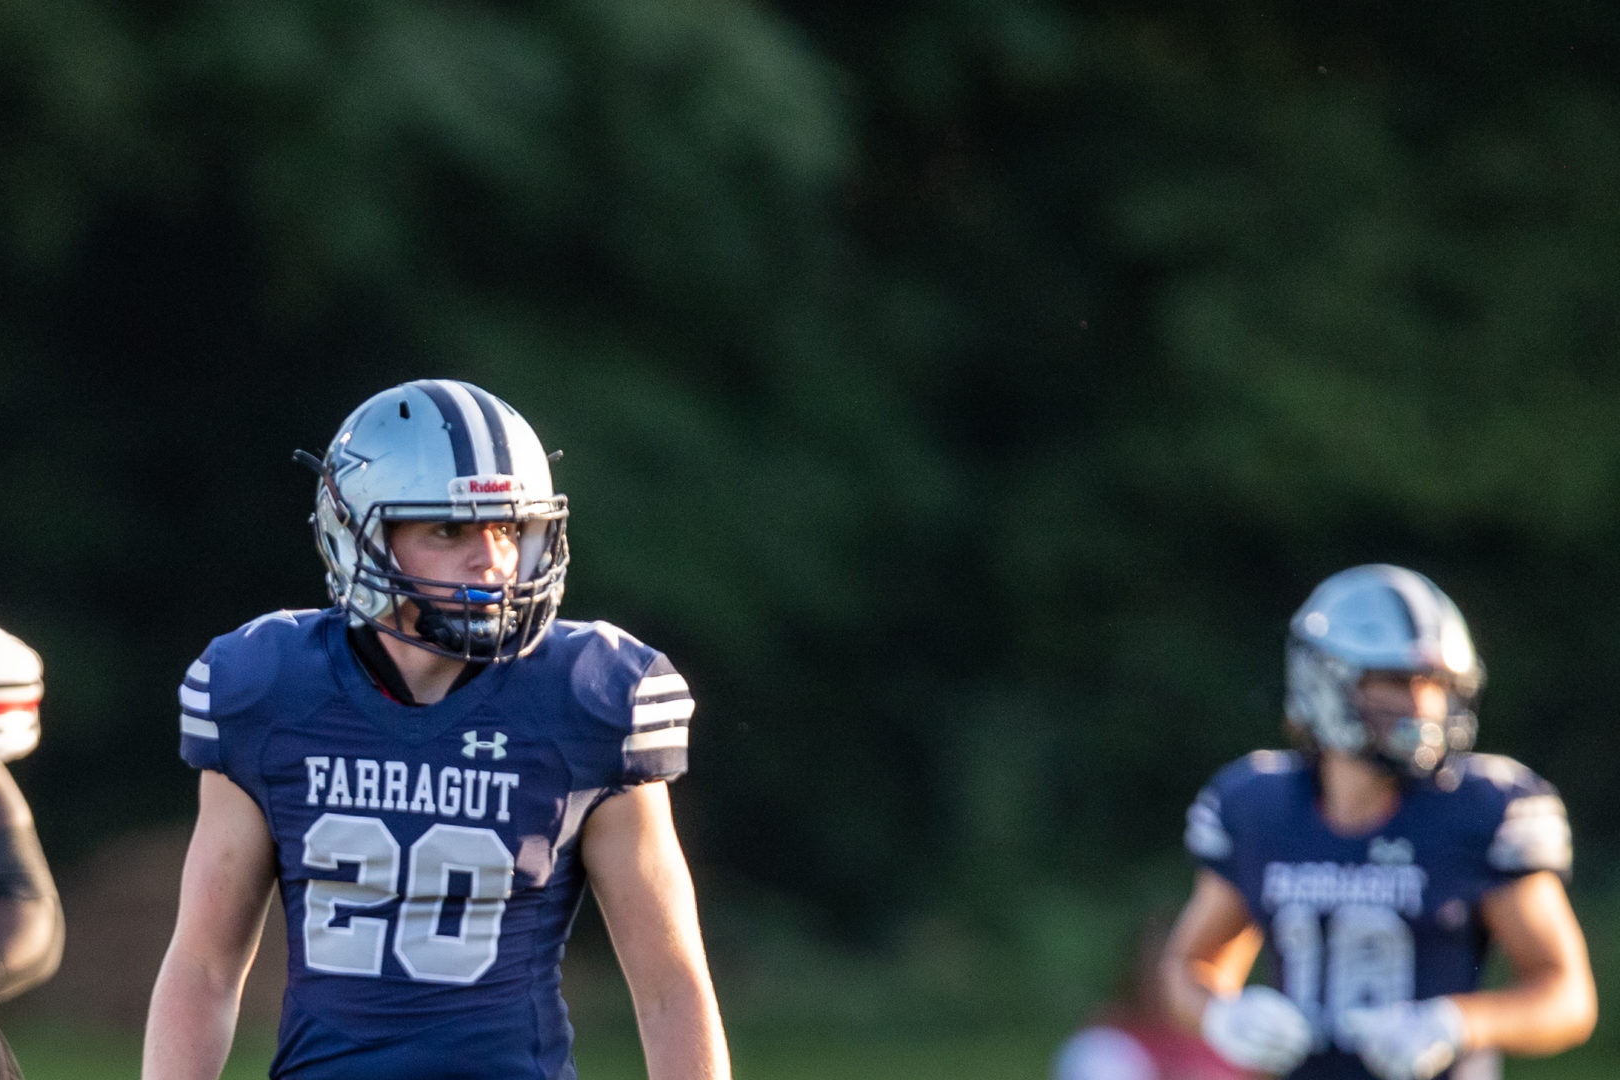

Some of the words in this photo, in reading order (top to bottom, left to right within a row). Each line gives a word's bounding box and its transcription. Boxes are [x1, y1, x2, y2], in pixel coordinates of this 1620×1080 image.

[469, 480, 512, 493] Riddell
[304, 756, 520, 823] FARRAGUT
[302, 812, 516, 986] 20
